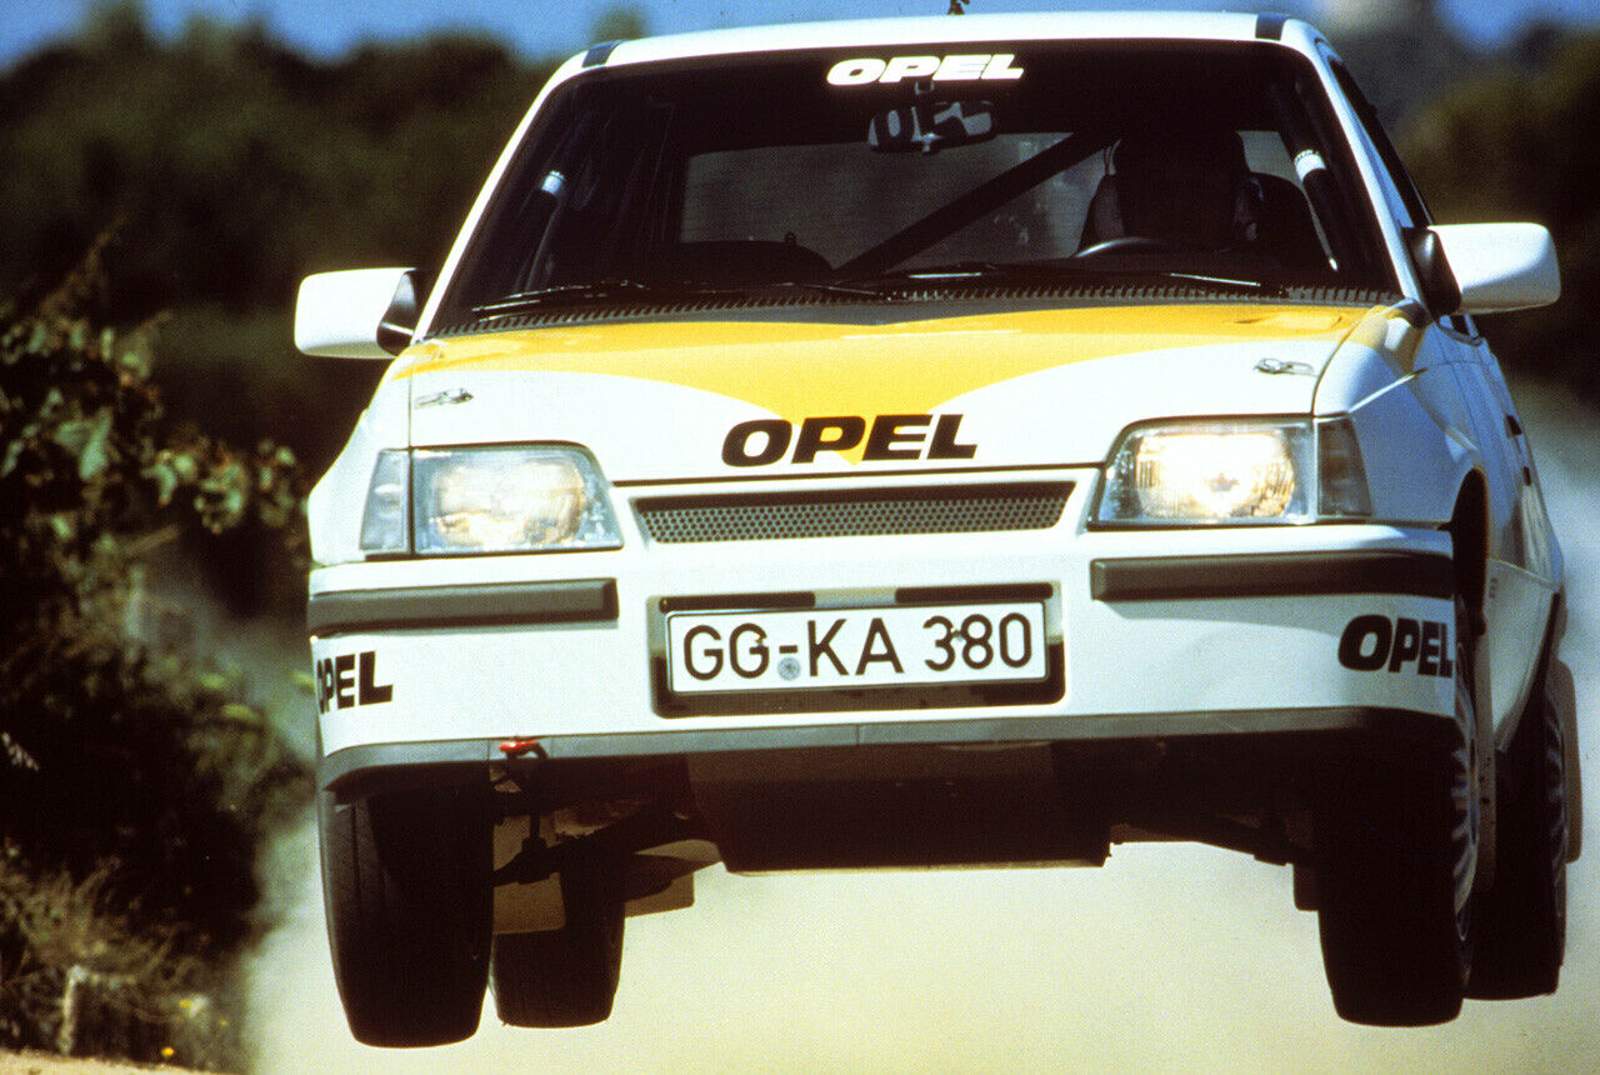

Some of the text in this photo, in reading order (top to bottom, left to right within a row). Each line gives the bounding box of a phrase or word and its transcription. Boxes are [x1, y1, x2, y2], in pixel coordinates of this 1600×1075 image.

[826, 54, 1024, 86] OPEL
[722, 413, 978, 467] OPEL
[683, 612, 1032, 681] GG-KA 380
[1338, 614, 1453, 679] OPEL
